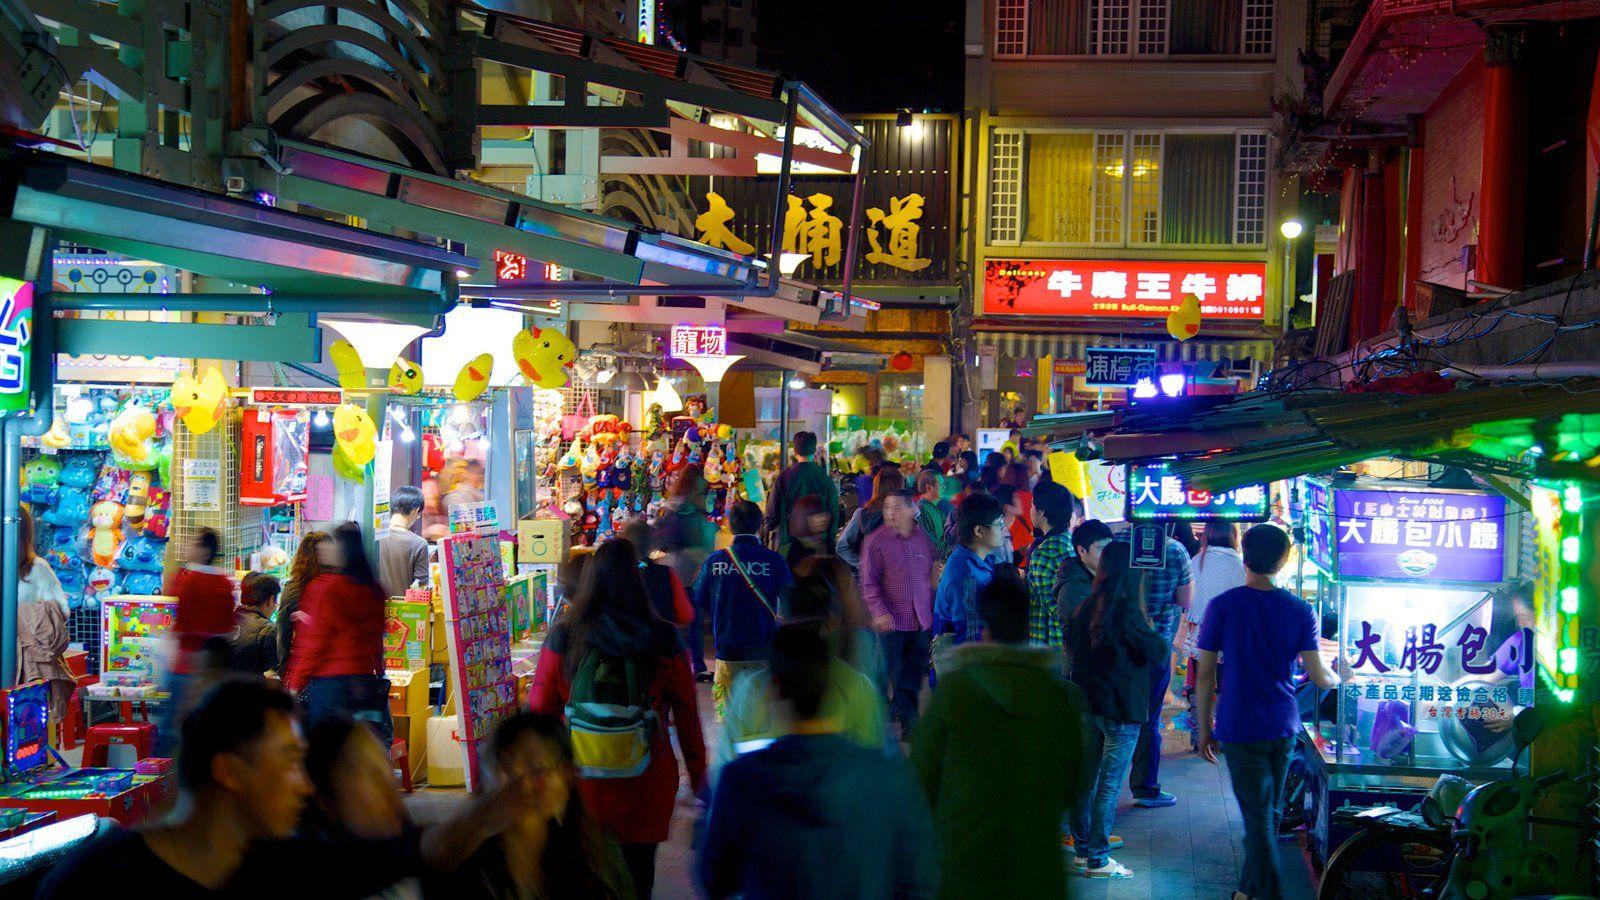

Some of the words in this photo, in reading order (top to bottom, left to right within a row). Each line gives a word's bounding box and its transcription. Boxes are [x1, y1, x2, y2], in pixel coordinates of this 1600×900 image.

[1121, 303, 1181, 313] Bull-Demon.Ki
[675, 328, 722, 355] 寵物
[1338, 516, 1499, 550] 大腸包小腸
[712, 561, 771, 577] FRANCE
